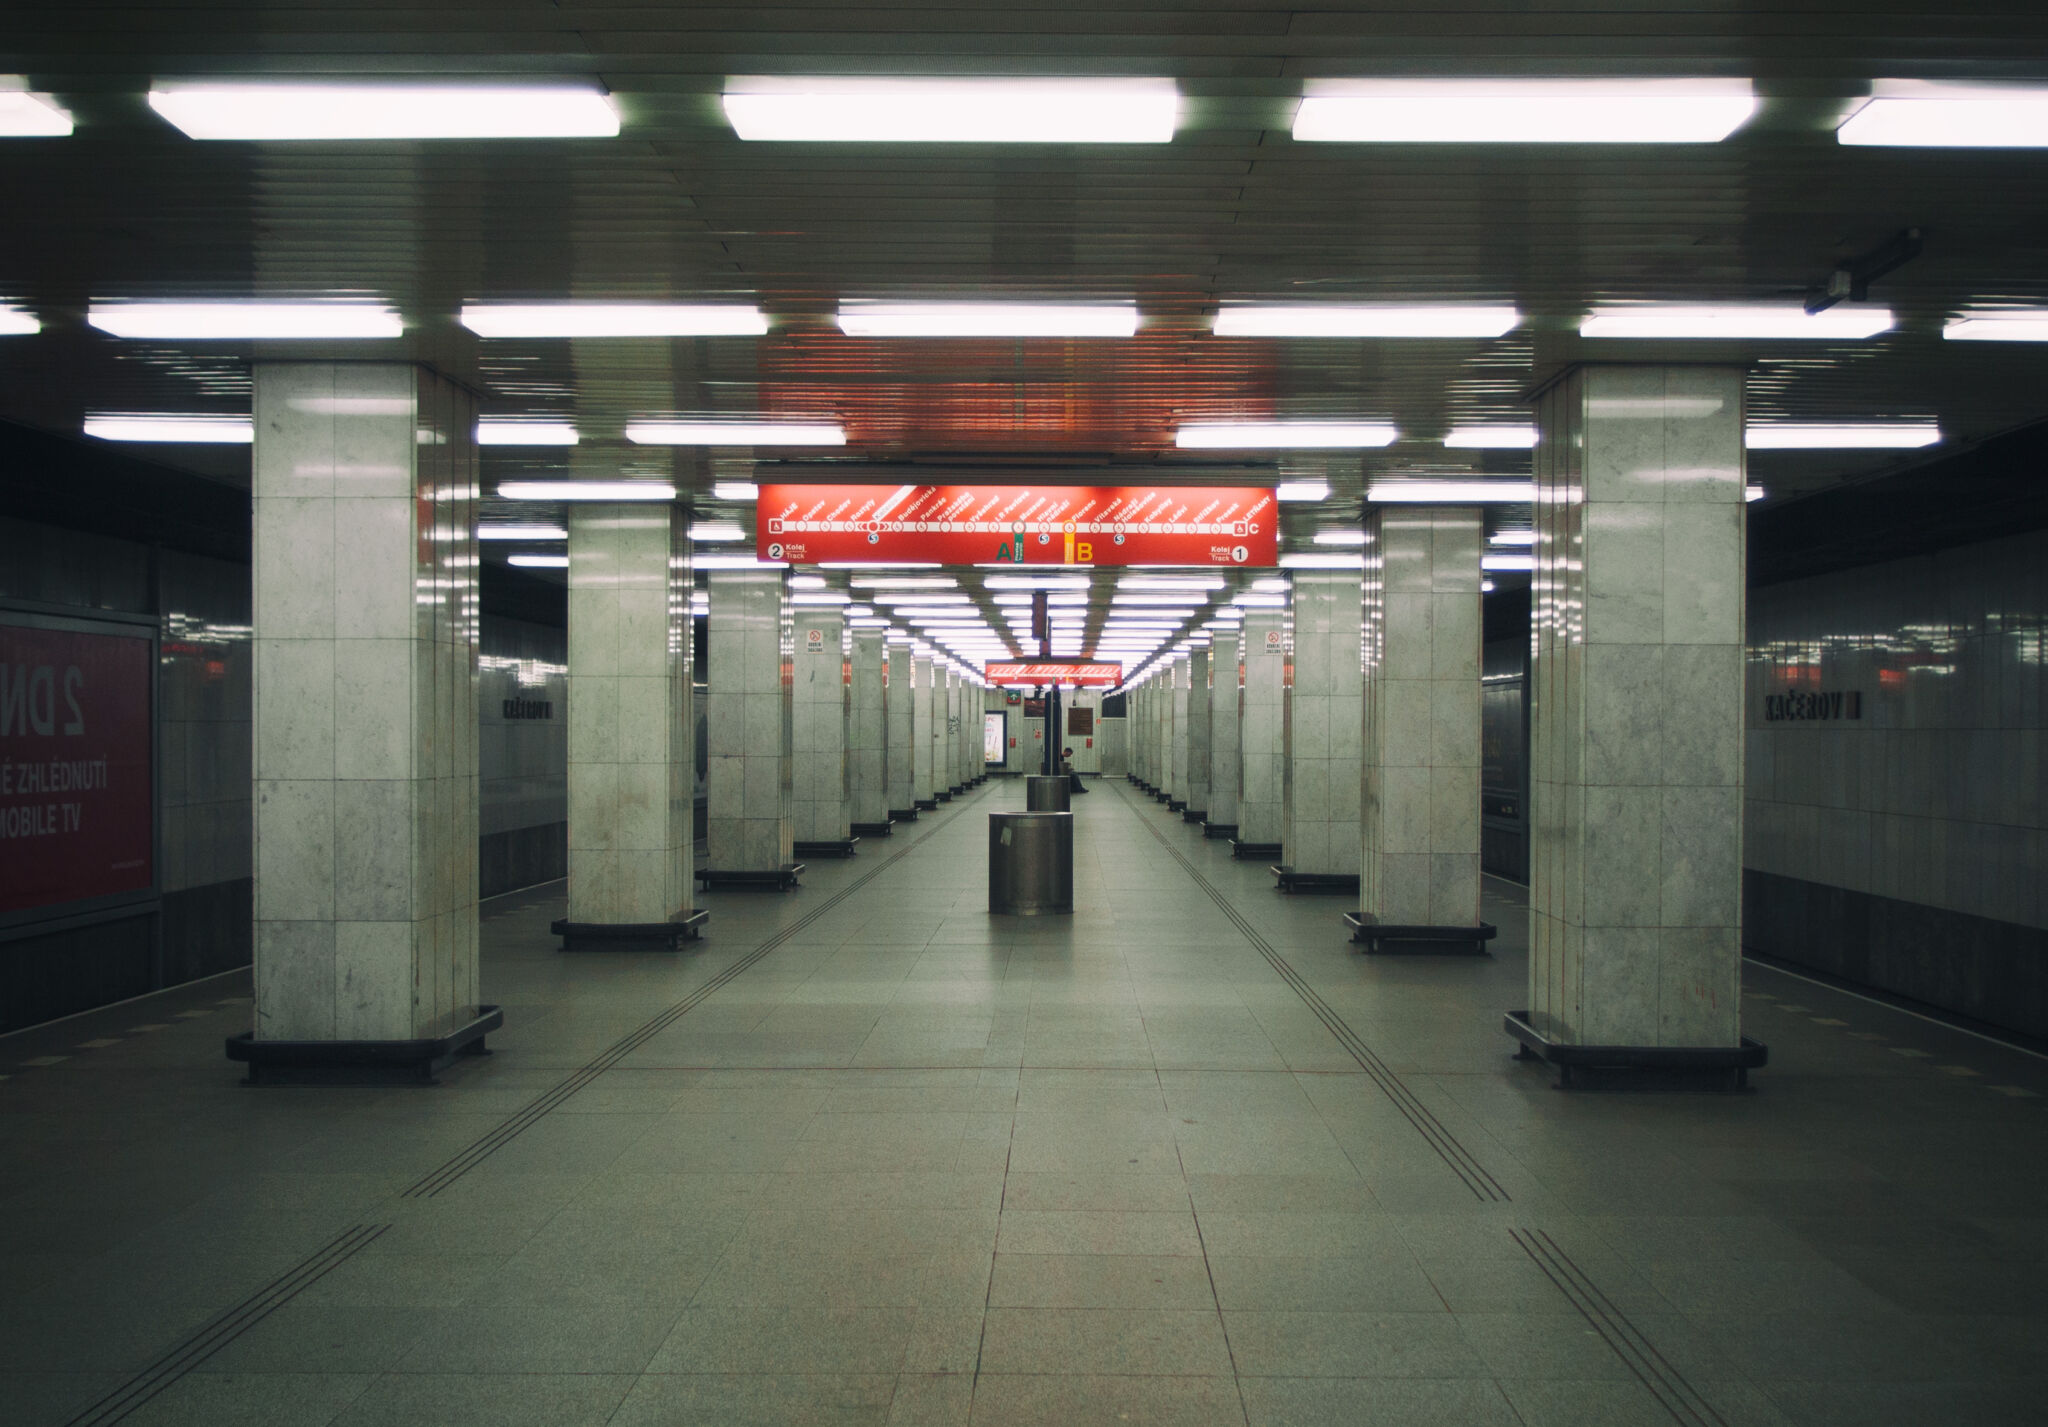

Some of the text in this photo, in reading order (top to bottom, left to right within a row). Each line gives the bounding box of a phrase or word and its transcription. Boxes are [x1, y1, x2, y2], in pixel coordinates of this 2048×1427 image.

[826, 498, 851, 522] Chodov
[1071, 499, 1097, 522] Florenc
[1249, 523, 1259, 534] C
[772, 545, 780, 557] 2
[786, 544, 805, 552] Kolej
[996, 542, 1012, 561] A
[1077, 542, 1093, 561] B
[1211, 546, 1230, 555] Kolej
[1236, 548, 1242, 560] 1
[16, 752, 107, 794] ZHLÉDNUTÍ
[61, 802, 81, 833] TV
